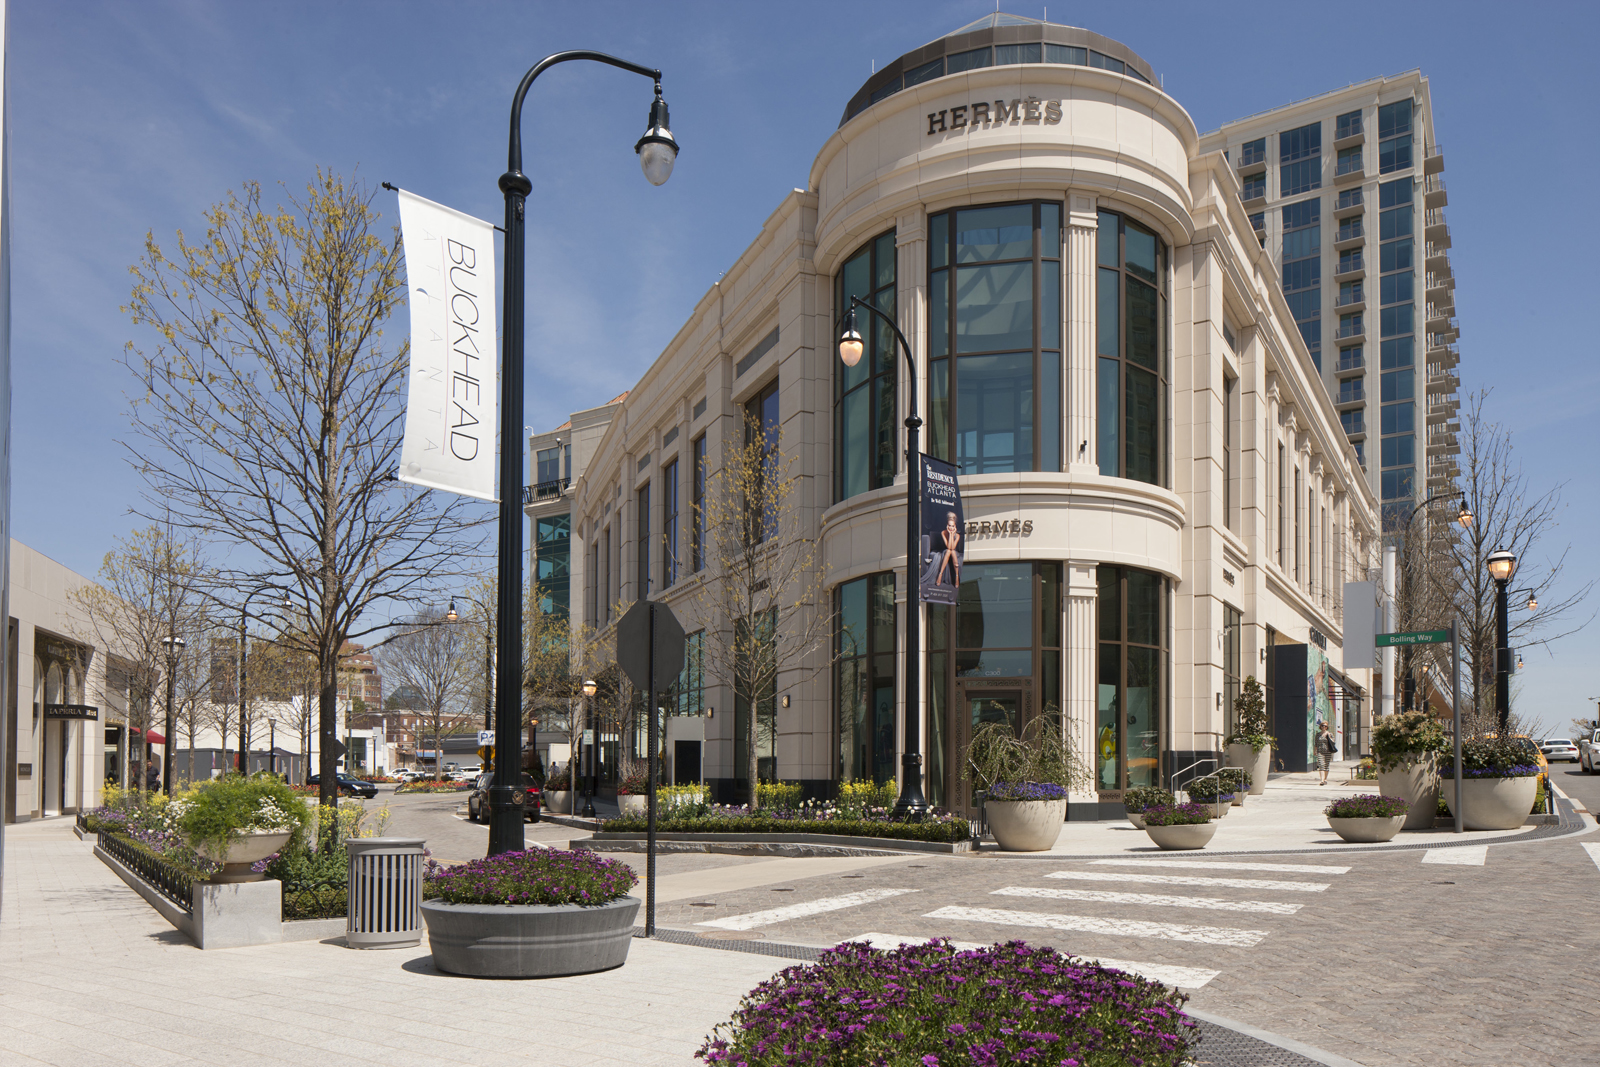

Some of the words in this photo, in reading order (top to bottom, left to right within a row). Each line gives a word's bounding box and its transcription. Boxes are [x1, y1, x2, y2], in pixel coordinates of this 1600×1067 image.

[927, 95, 1062, 136] HERMÈS
[422, 228, 443, 451] ATLANTA
[447, 238, 480, 461] BUCKHEAD
[927, 471, 954, 484] RESIDENCE
[927, 481, 956, 492] BUCKHEAD
[927, 487, 957, 499] ATLANTA
[964, 518, 1034, 535] ERMÈS
[1389, 635, 1416, 643] Bolling
